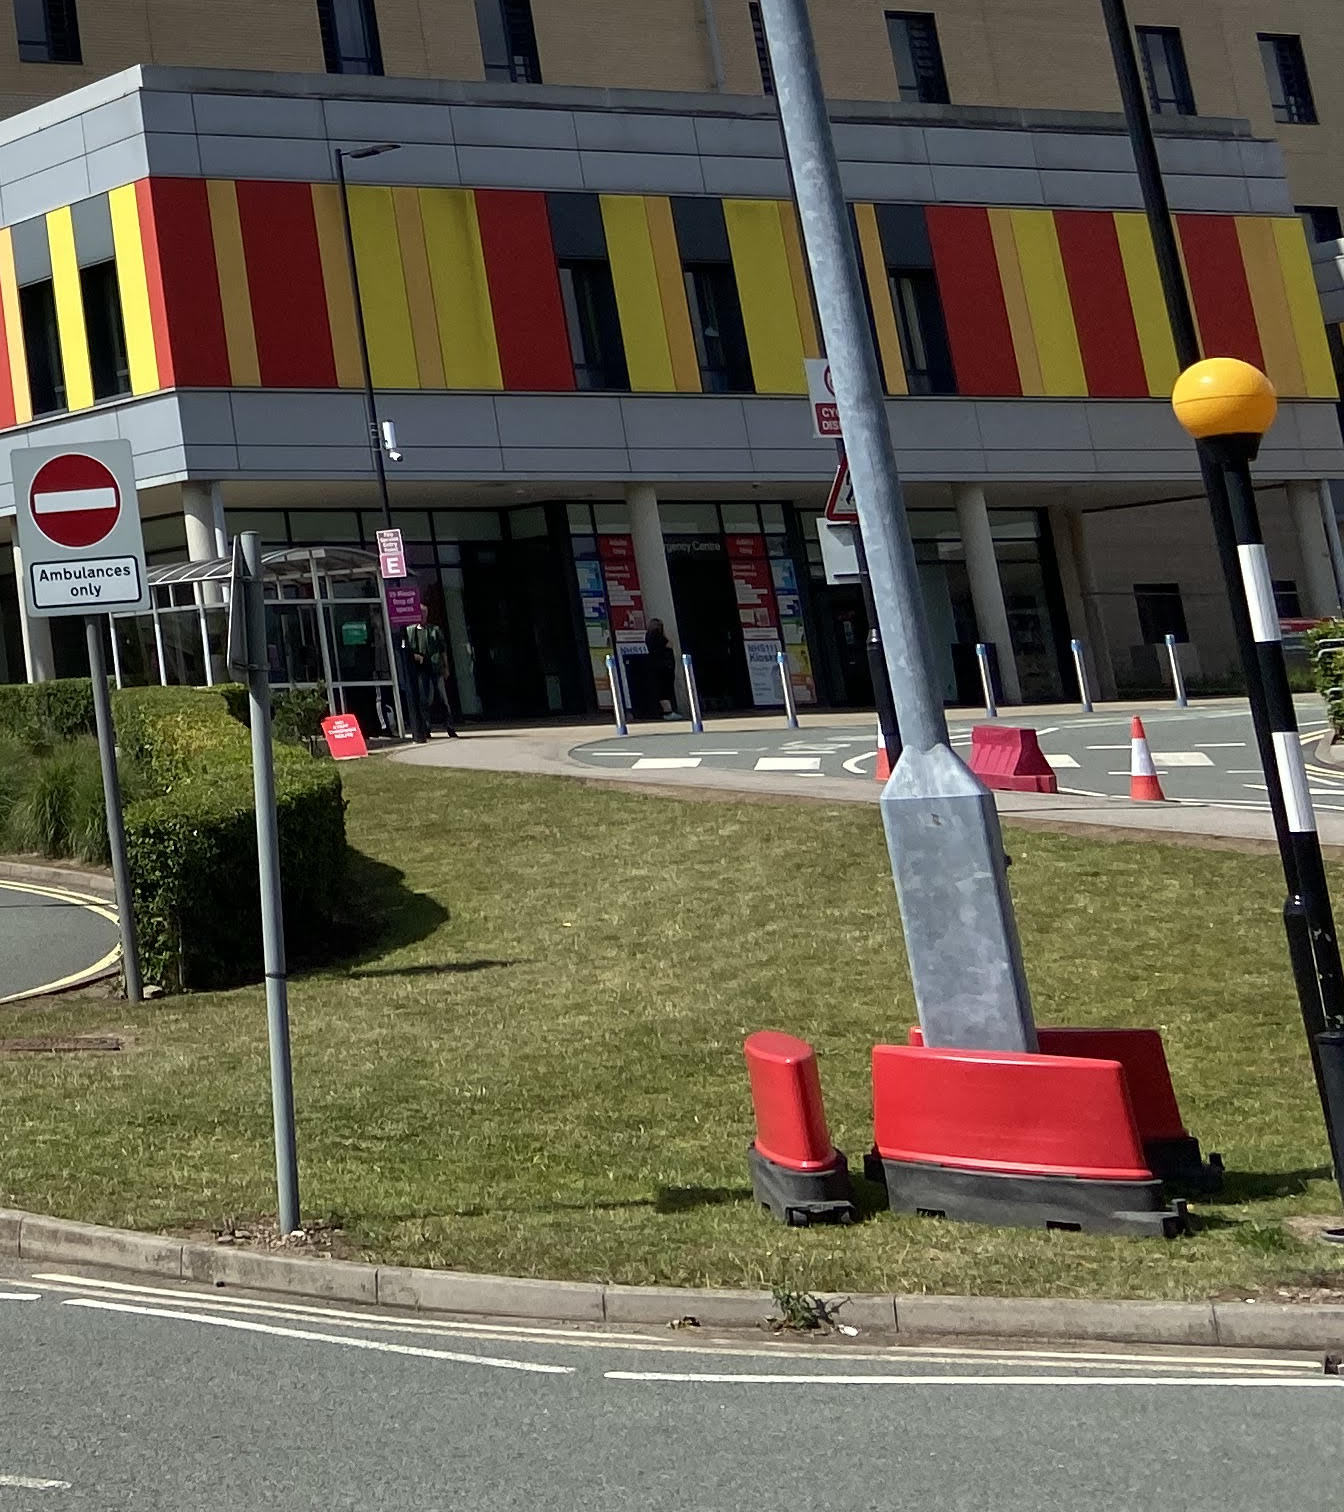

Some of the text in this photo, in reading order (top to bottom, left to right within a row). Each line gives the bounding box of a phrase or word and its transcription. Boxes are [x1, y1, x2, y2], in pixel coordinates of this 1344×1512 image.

[387, 557, 401, 574] E
[39, 566, 131, 582] Ambulances
[70, 583, 102, 597] only
